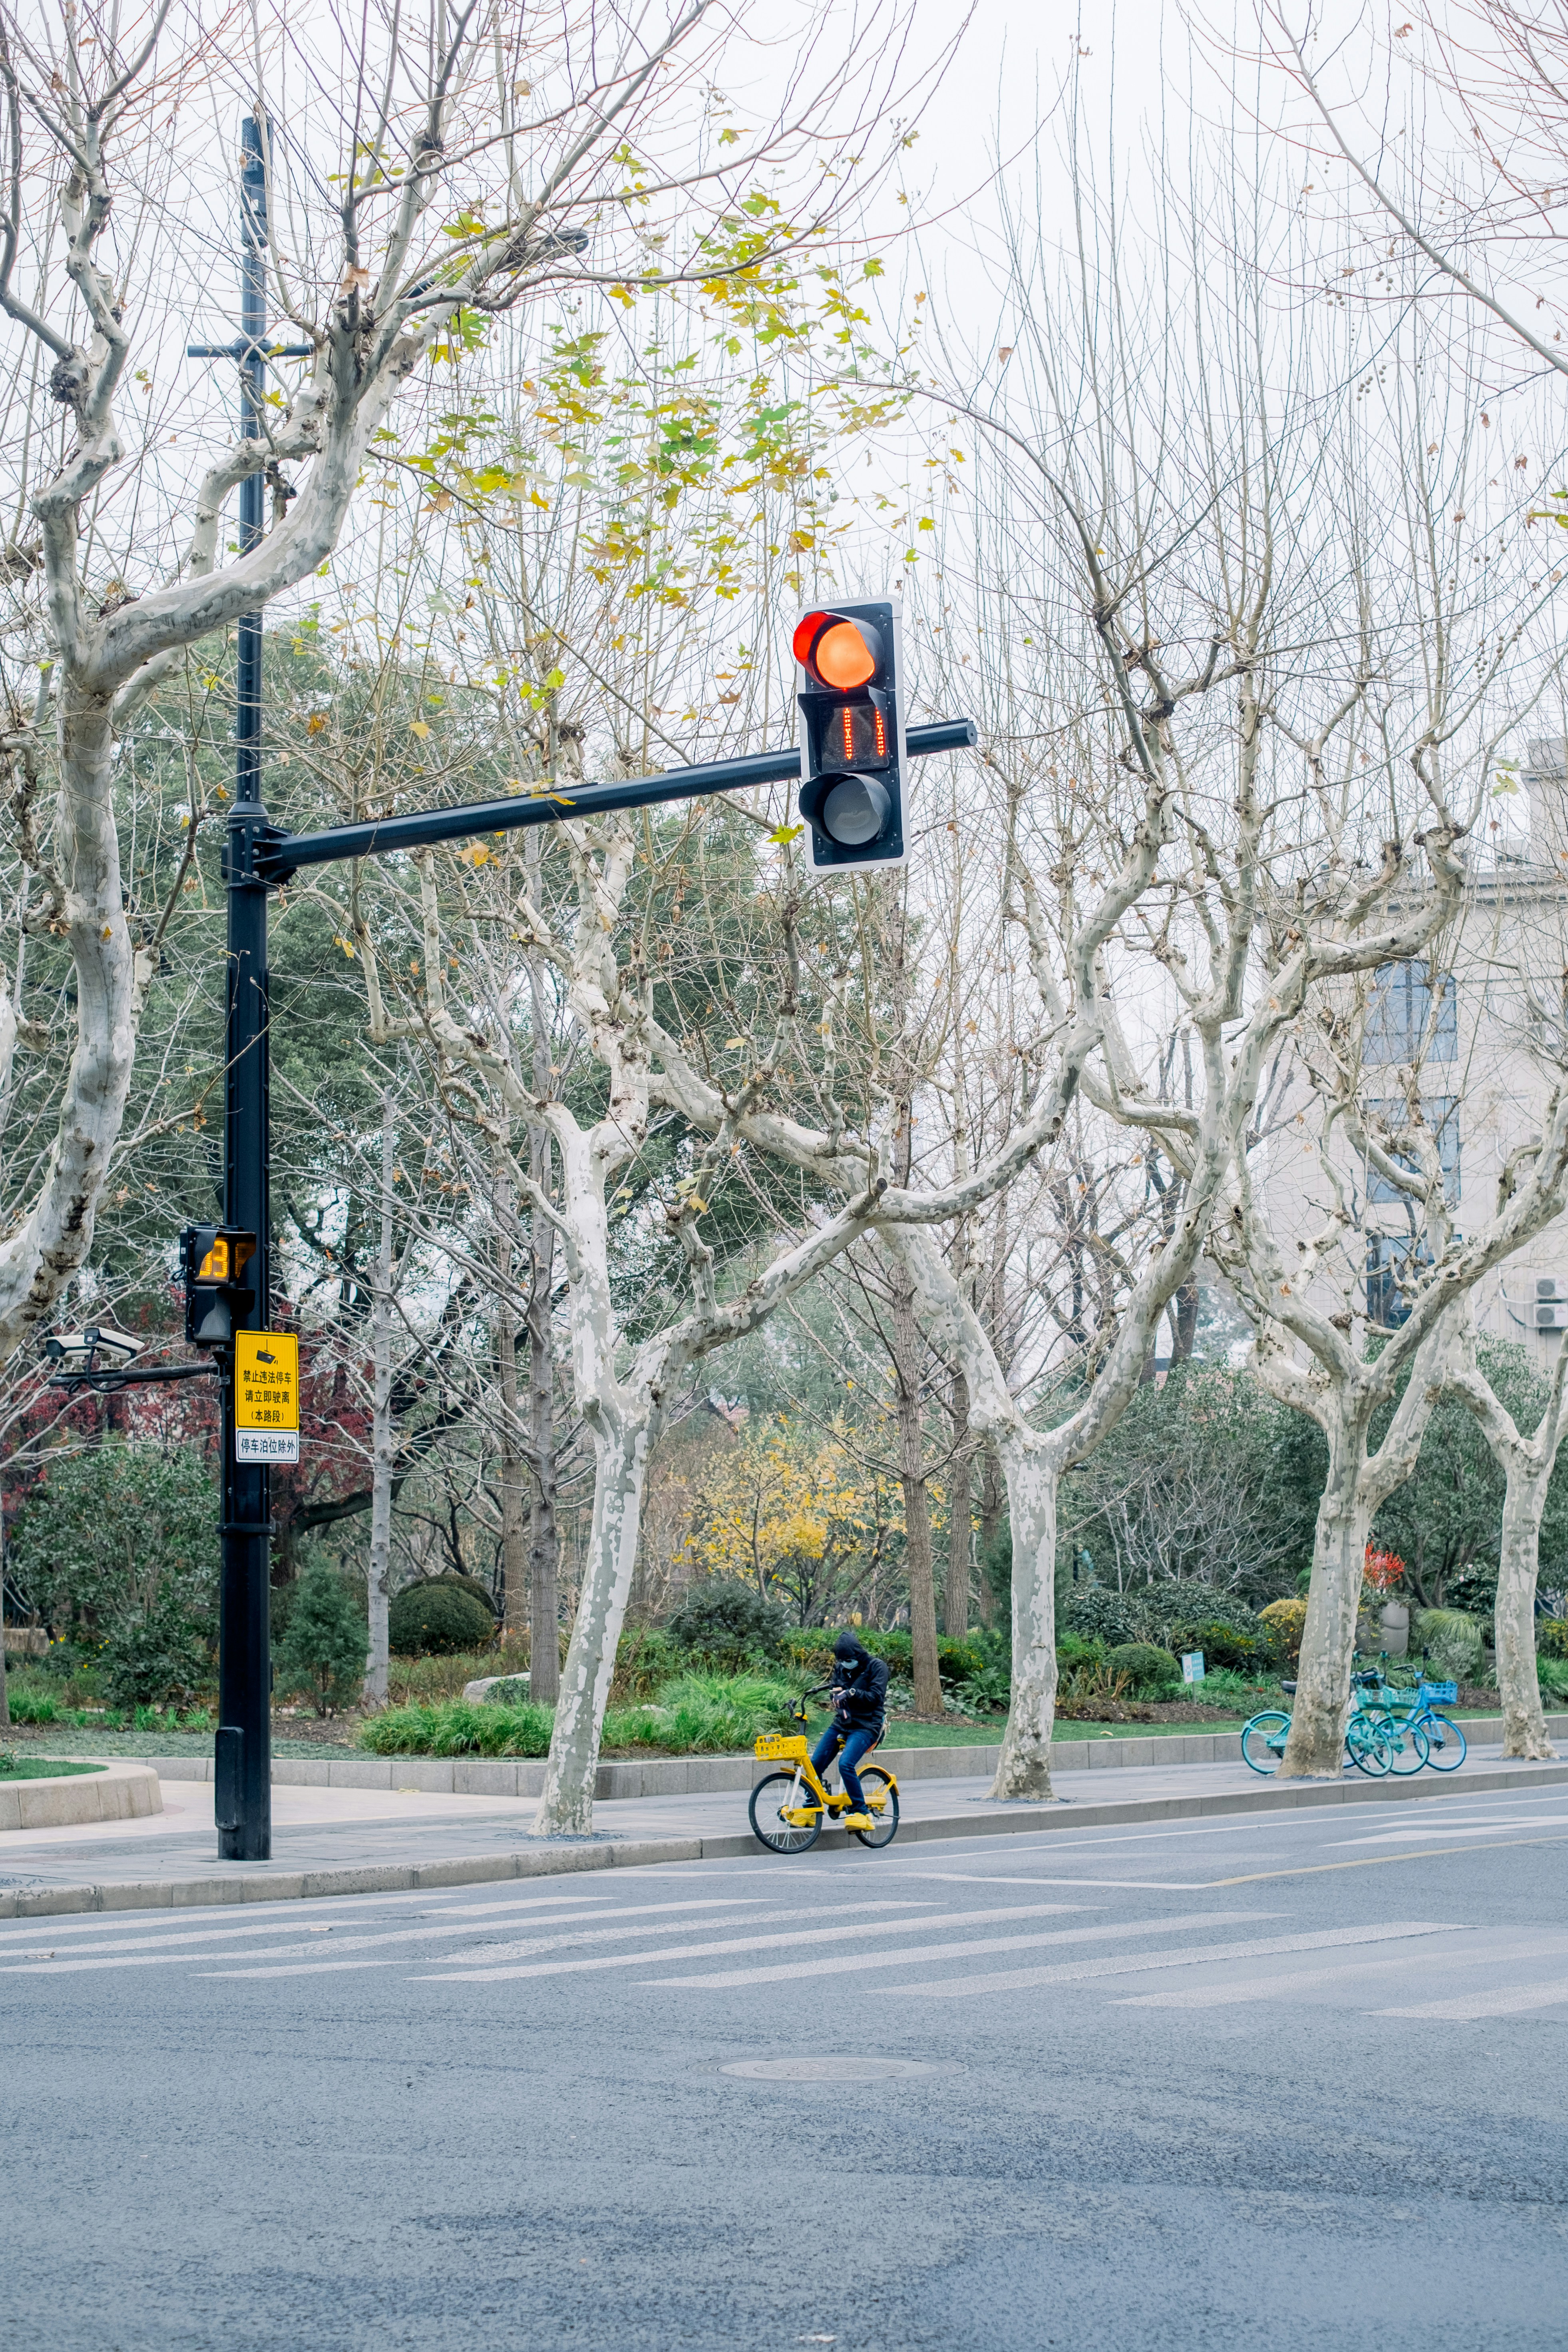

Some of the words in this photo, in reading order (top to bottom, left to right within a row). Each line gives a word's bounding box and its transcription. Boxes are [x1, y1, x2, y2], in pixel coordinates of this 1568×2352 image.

[243, 1369, 292, 1385] 禁止违法停车
[245, 1389, 290, 1404] 请立即驶离
[251, 1409, 284, 1423] （本路段）
[241, 1438, 295, 1454] 停车泊位除外
